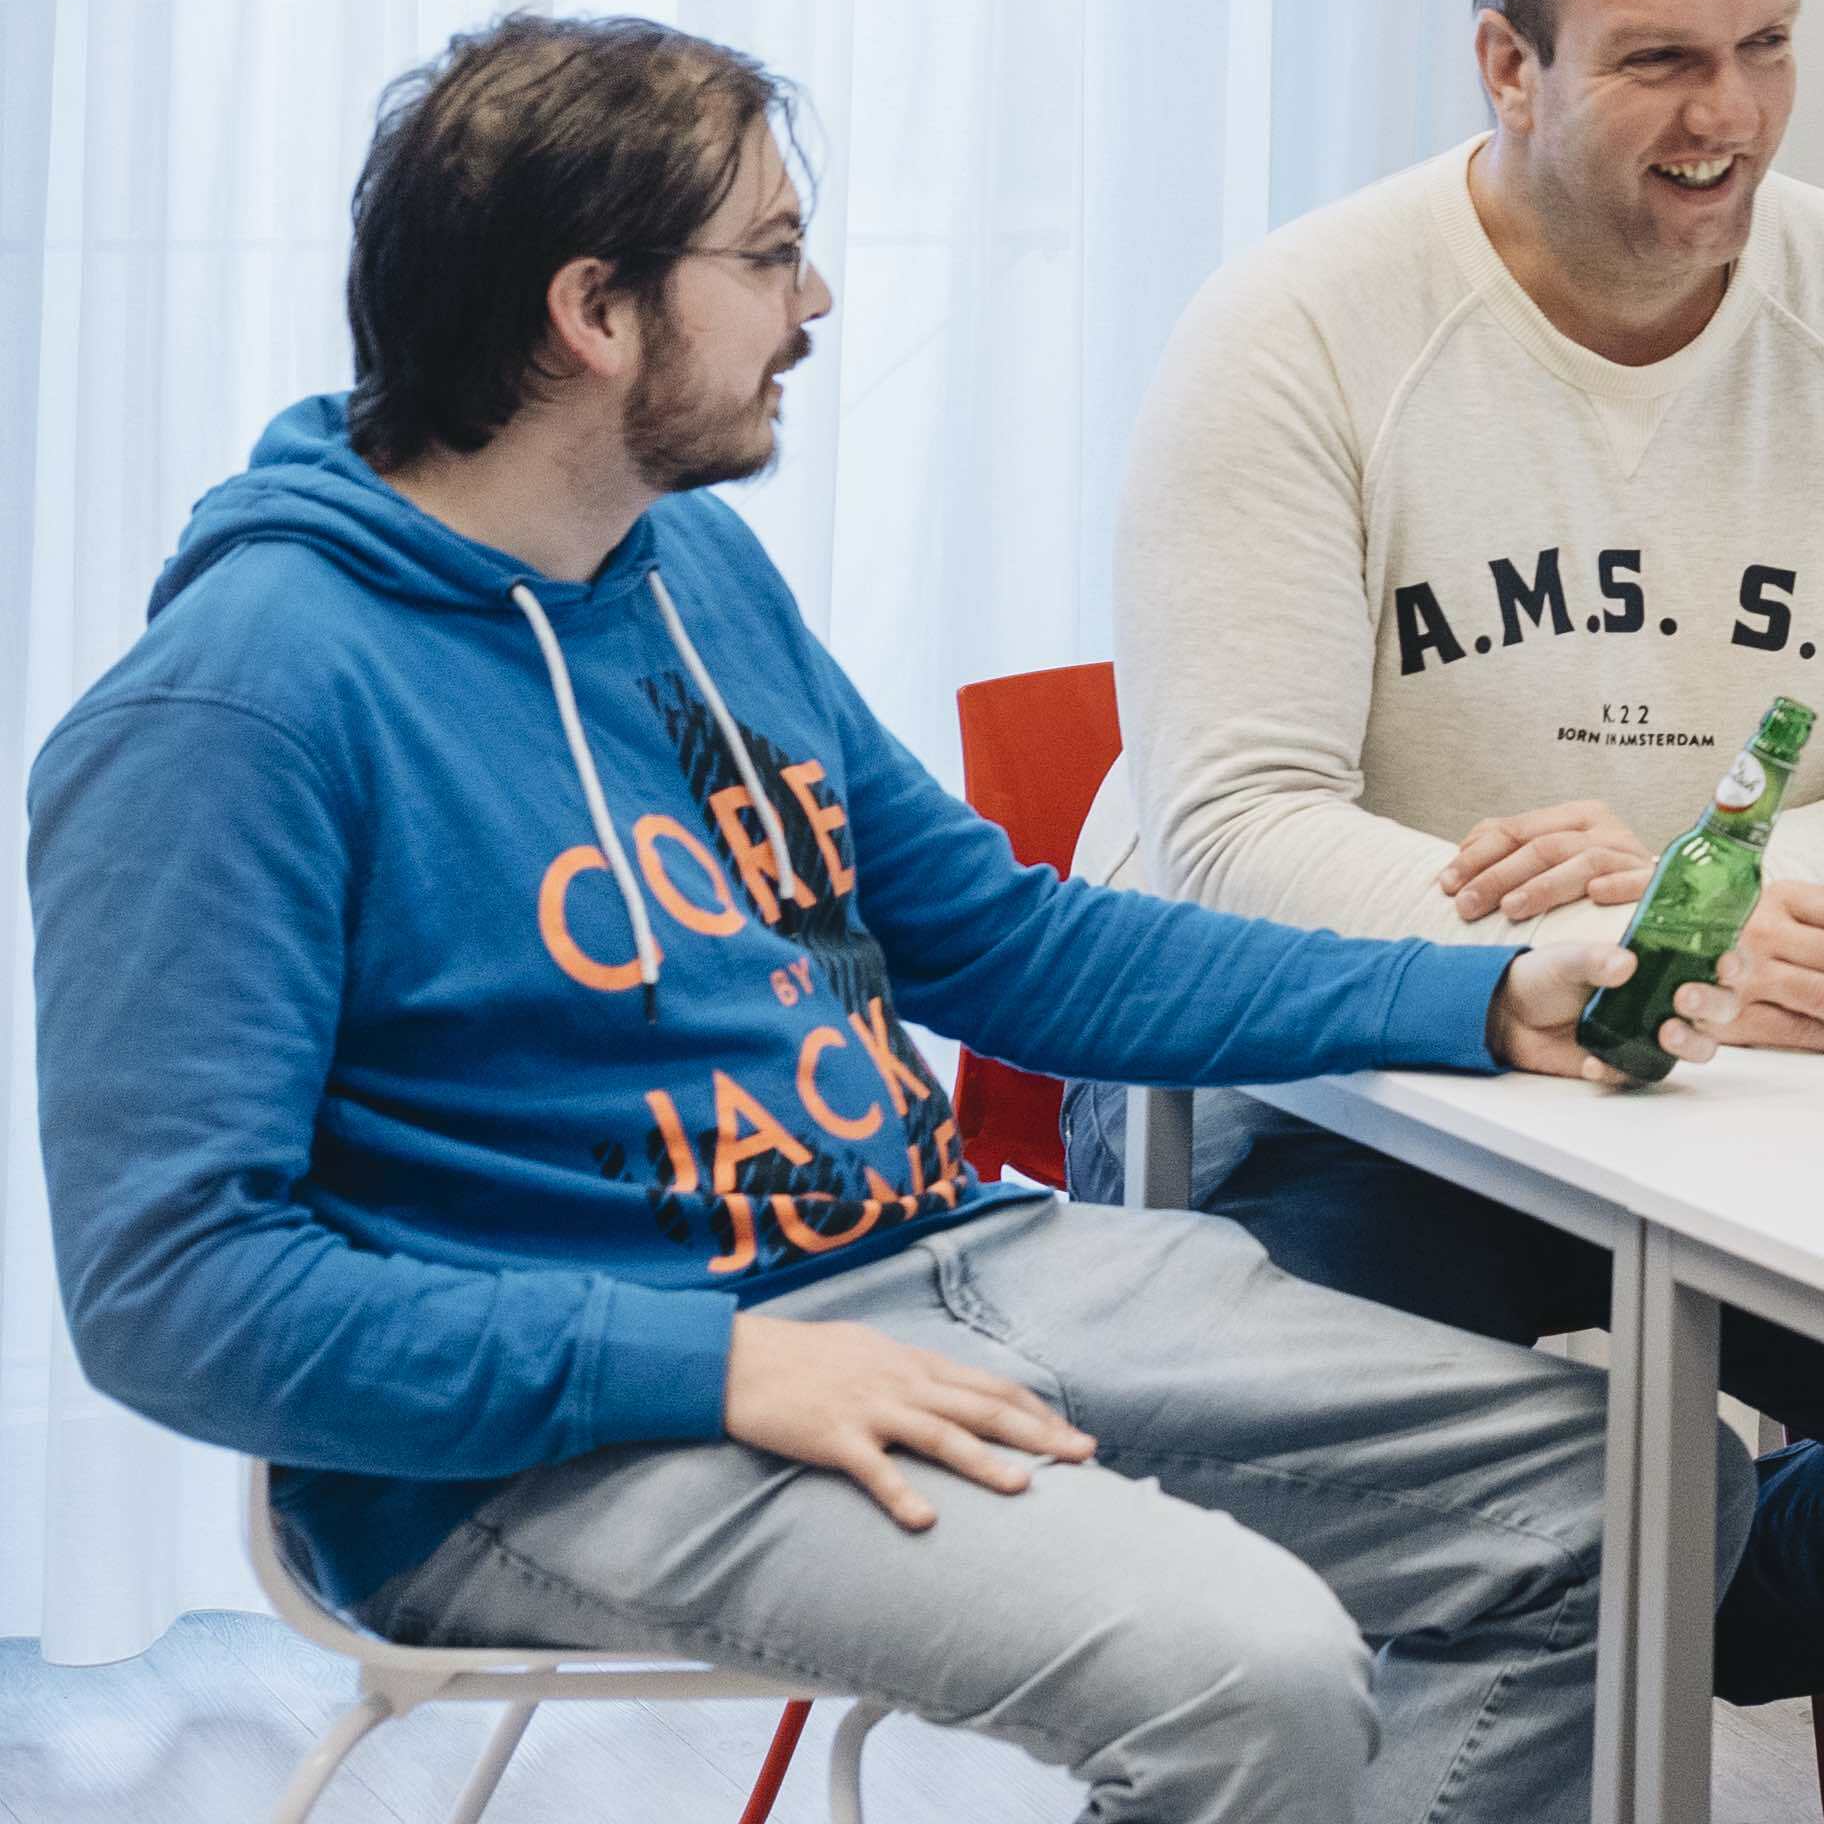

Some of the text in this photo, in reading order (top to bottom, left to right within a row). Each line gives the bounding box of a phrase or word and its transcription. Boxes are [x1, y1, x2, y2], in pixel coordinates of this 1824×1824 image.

[1557, 727, 1715, 747] BORN IN AMSTERDAM
[538, 758, 856, 991] CORE
[769, 957, 814, 1007] BY
[645, 995, 930, 1194] JACK
